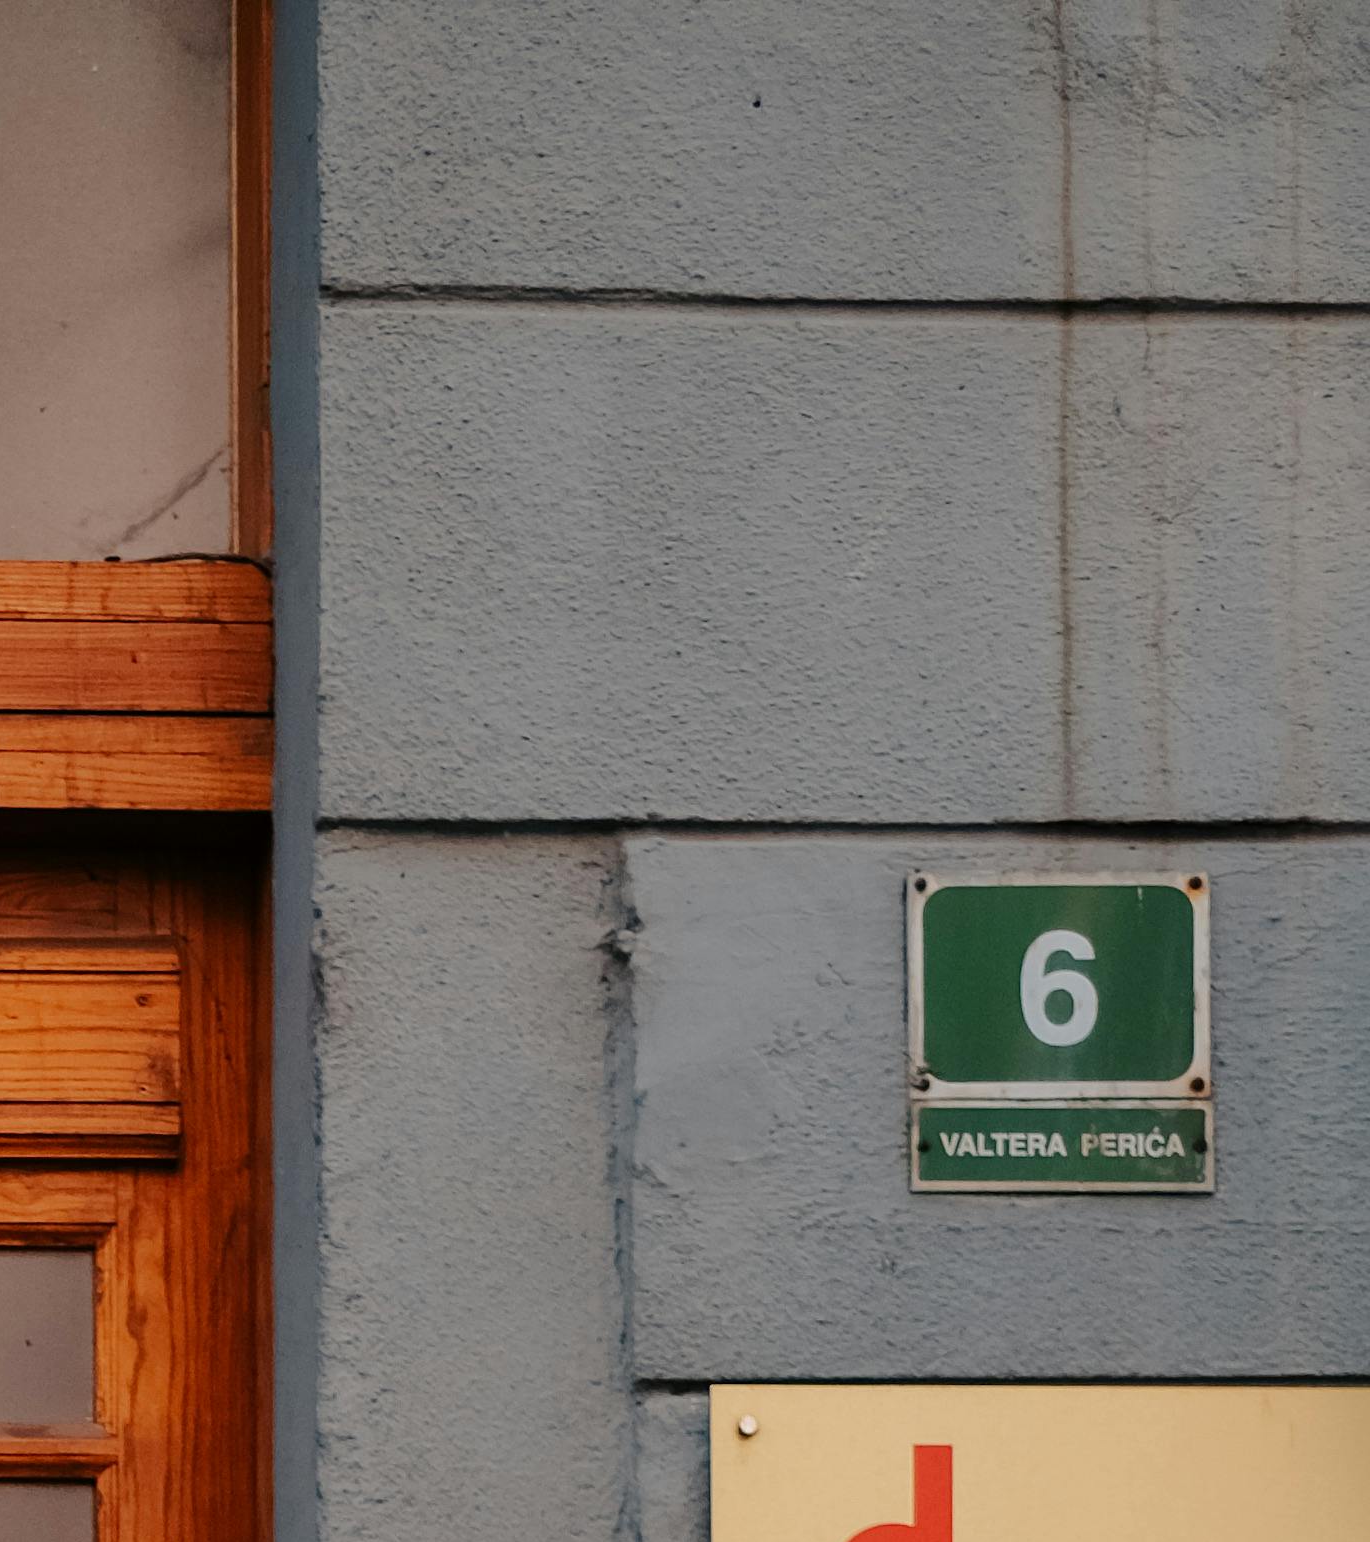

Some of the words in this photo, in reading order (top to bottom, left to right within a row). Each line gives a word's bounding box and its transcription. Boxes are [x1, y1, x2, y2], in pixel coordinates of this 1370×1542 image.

[1019, 929, 1099, 1048] 6
[939, 1131, 1068, 1159] VALTERA
[1080, 1126, 1186, 1159] PERIĆA
